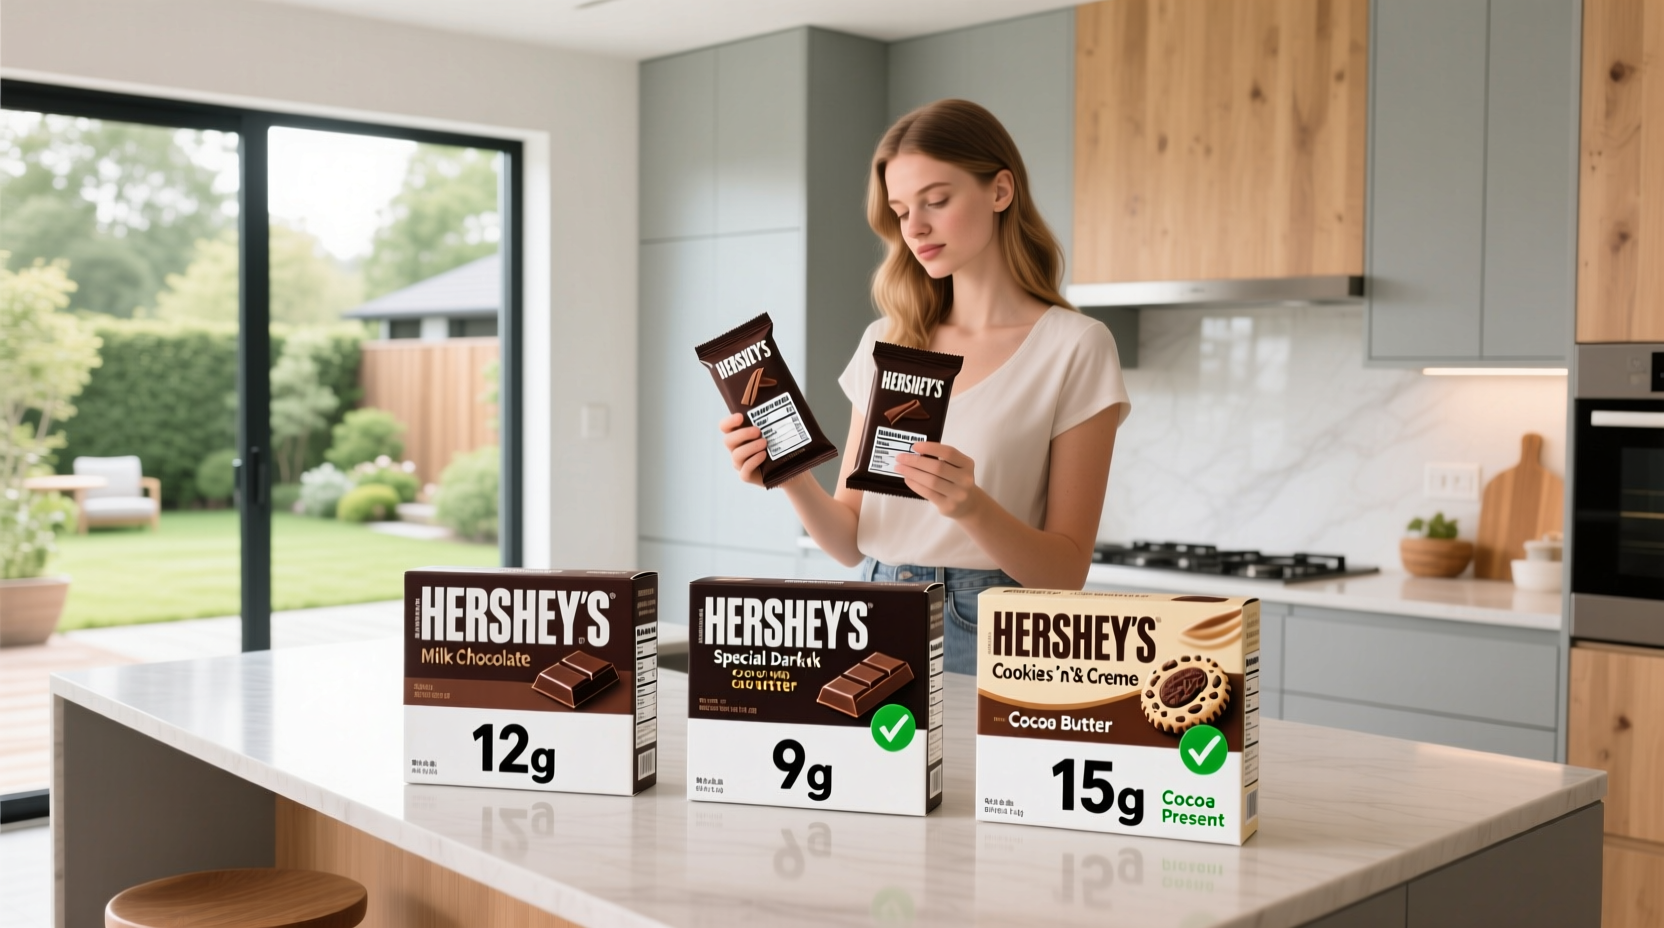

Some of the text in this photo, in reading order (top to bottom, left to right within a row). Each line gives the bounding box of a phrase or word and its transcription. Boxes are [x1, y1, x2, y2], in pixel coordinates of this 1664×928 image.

[421, 586, 610, 647] HERSHEY'S
[704, 596, 869, 650] HERSHEY'S
[421, 647, 531, 667] Milk Chocolate
[993, 611, 1156, 664] HERSHEY'S
[713, 649, 766, 668] Special
[992, 662, 1054, 682] Cookies
[1087, 667, 1139, 687] Creme
[1061, 715, 1113, 733] Butter
[472, 723, 556, 784] 12g
[772, 738, 833, 801] 9g
[1052, 758, 1144, 827] 15g
[1161, 790, 1215, 809] Cocoa
[1161, 809, 1225, 827] Present
